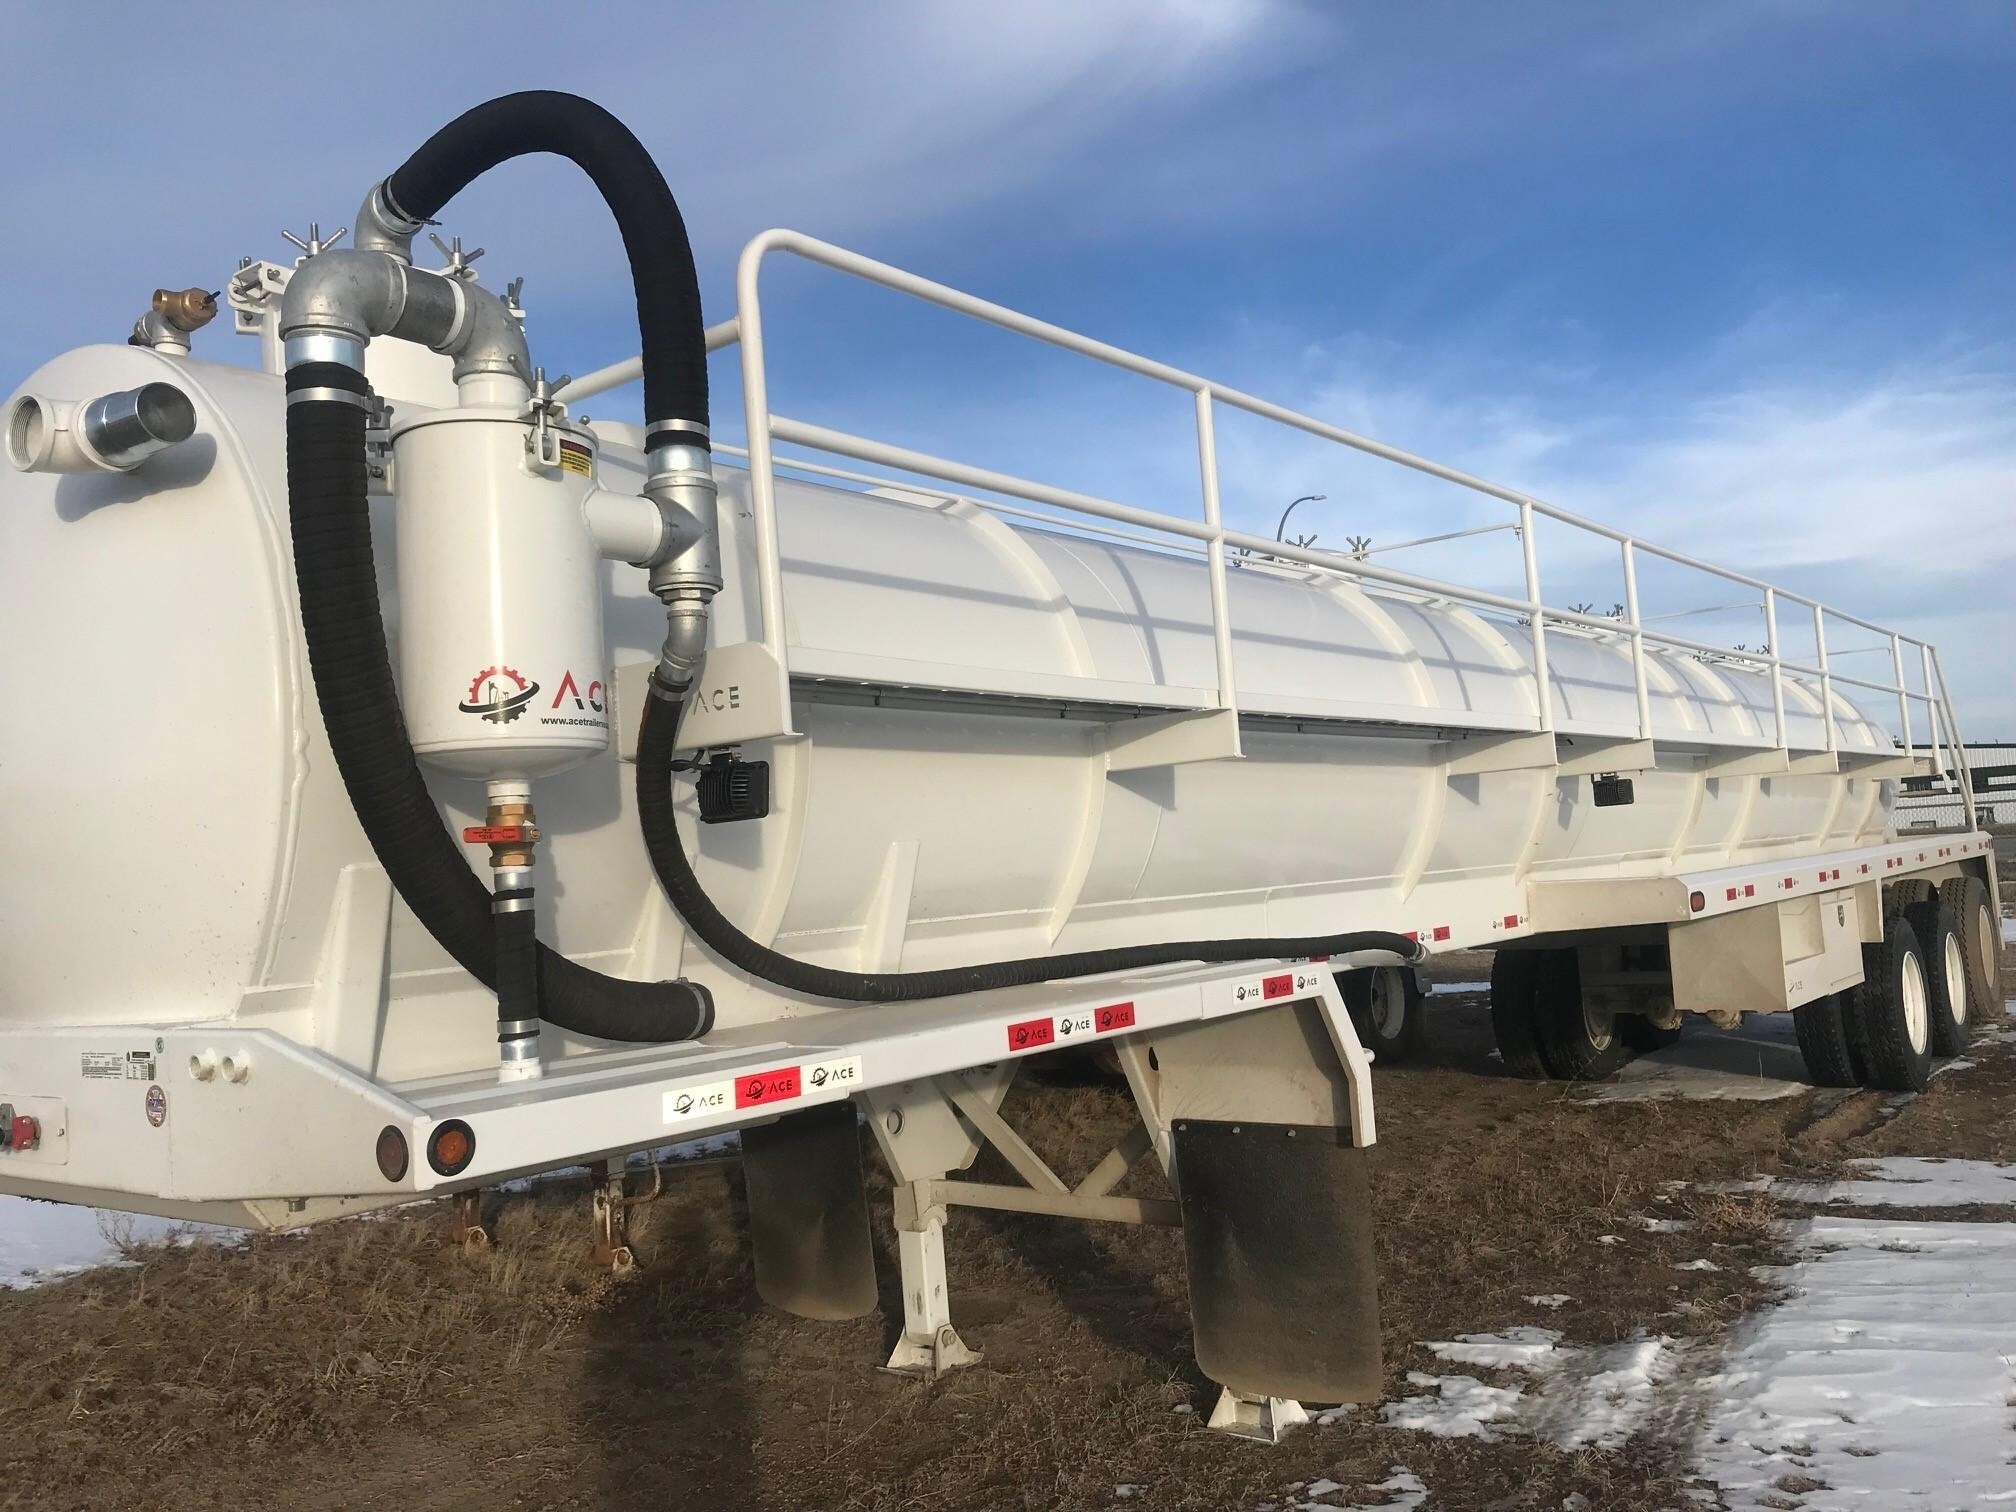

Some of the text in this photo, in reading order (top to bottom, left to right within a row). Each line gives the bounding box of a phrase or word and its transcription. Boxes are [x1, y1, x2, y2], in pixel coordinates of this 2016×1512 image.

[551, 669, 609, 714] AC
[693, 686, 740, 716] ACE
[1306, 977, 1318, 987] ACE
[1247, 987, 1260, 998] ACE
[1114, 1011, 1129, 1023] ACE
[1074, 1019, 1091, 1032] ACE
[1031, 1028, 1048, 1040] ACE
[831, 1067, 854, 1082] ACE
[768, 1079, 793, 1095] ACE
[699, 1093, 724, 1108] ACE
